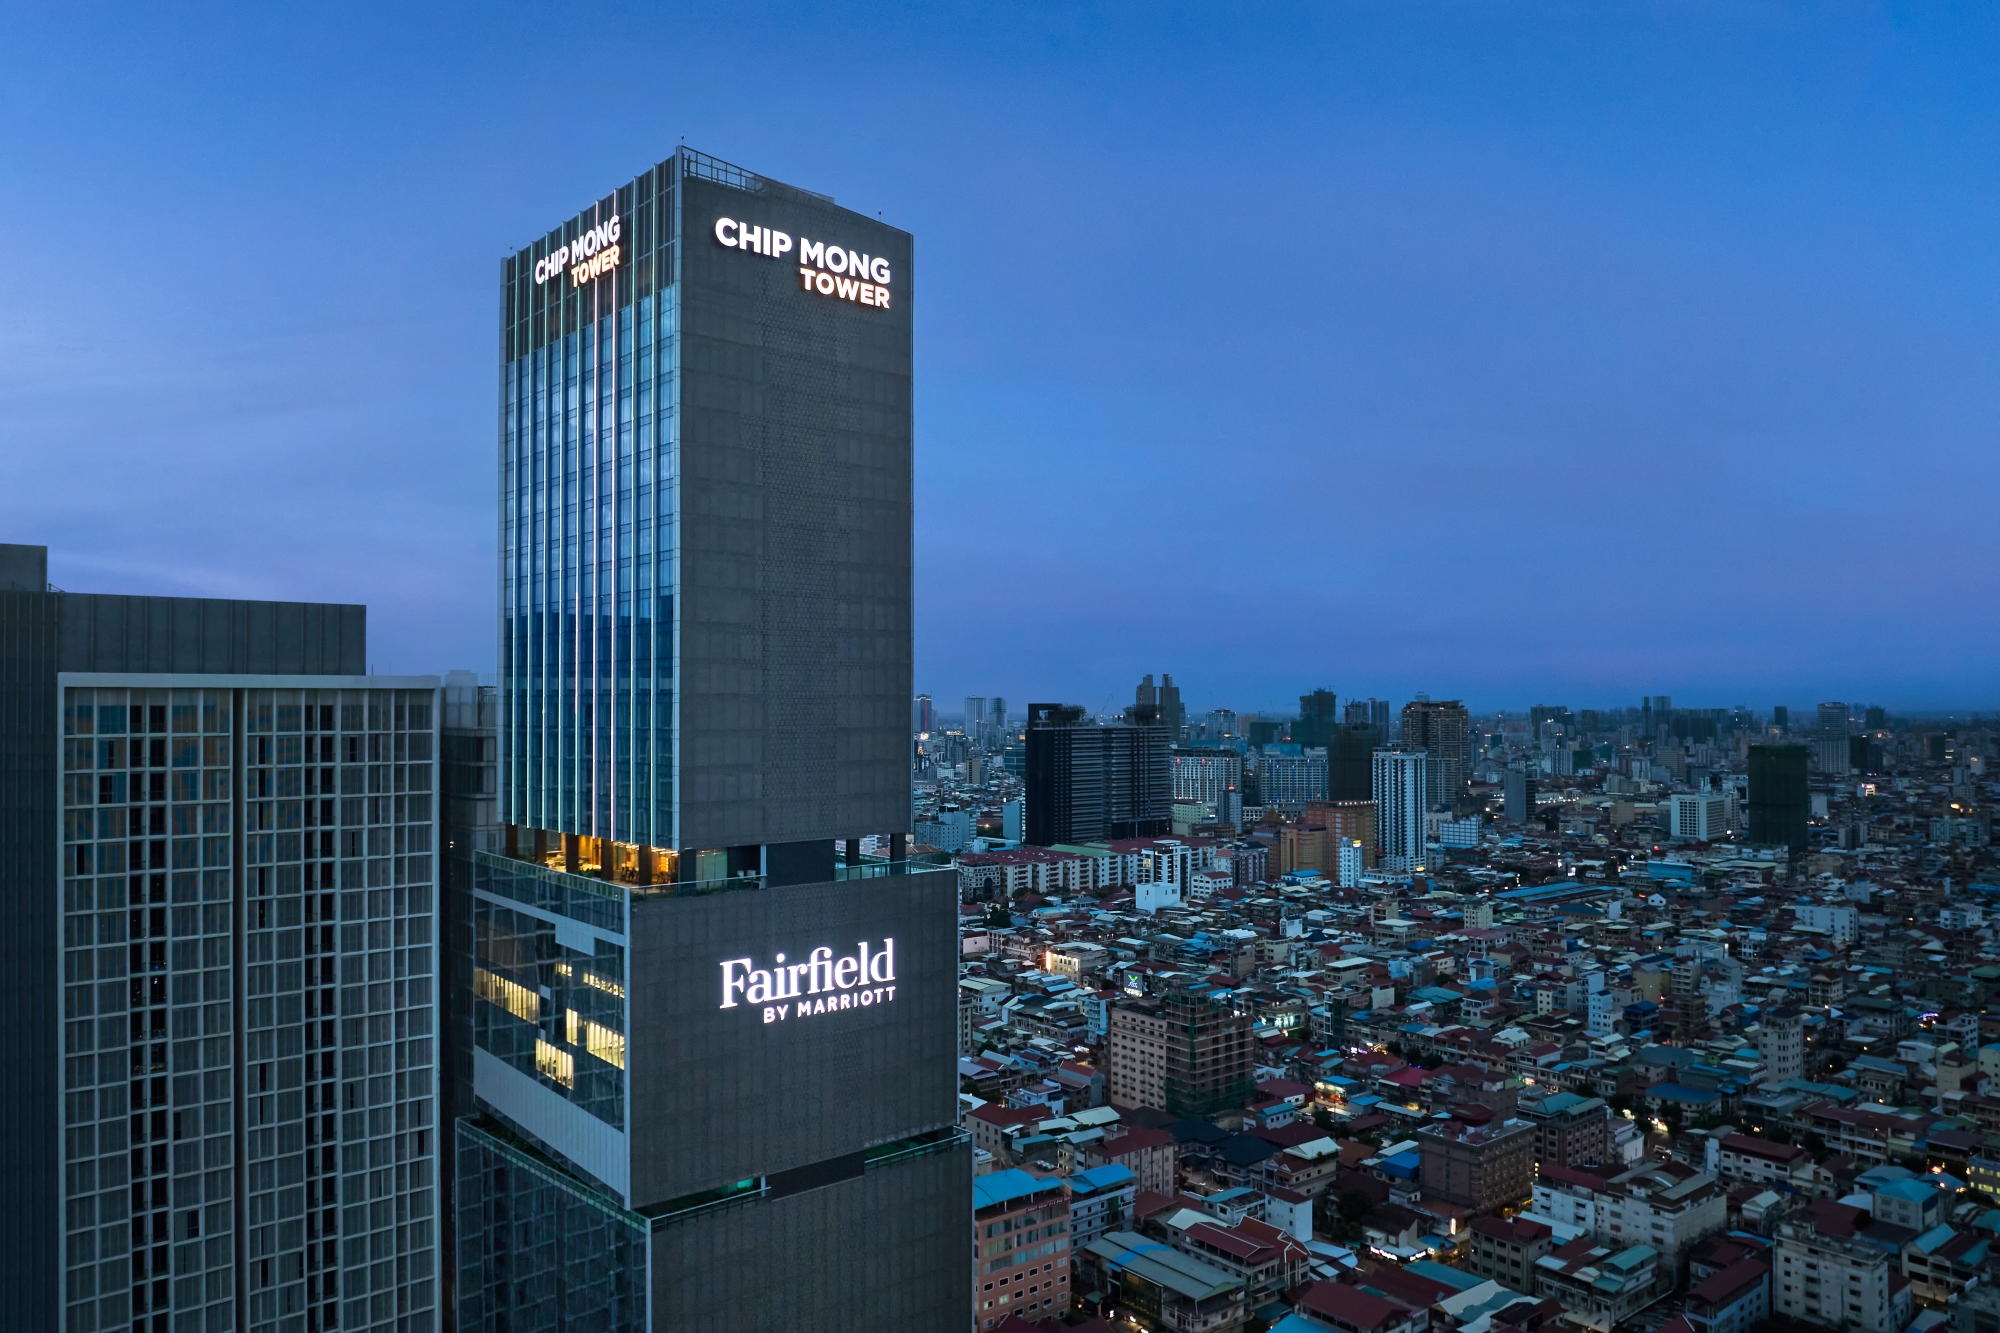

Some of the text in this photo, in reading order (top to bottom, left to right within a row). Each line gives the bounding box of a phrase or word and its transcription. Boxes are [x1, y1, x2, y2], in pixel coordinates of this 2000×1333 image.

[535, 215, 620, 285] CHIP MONG
[571, 245, 620, 288] TOWER
[715, 217, 891, 285] CHIP MONG
[799, 267, 890, 309] TOWER
[719, 937, 896, 1010] Fairfield
[763, 985, 897, 1024] BY MARRIOTT
